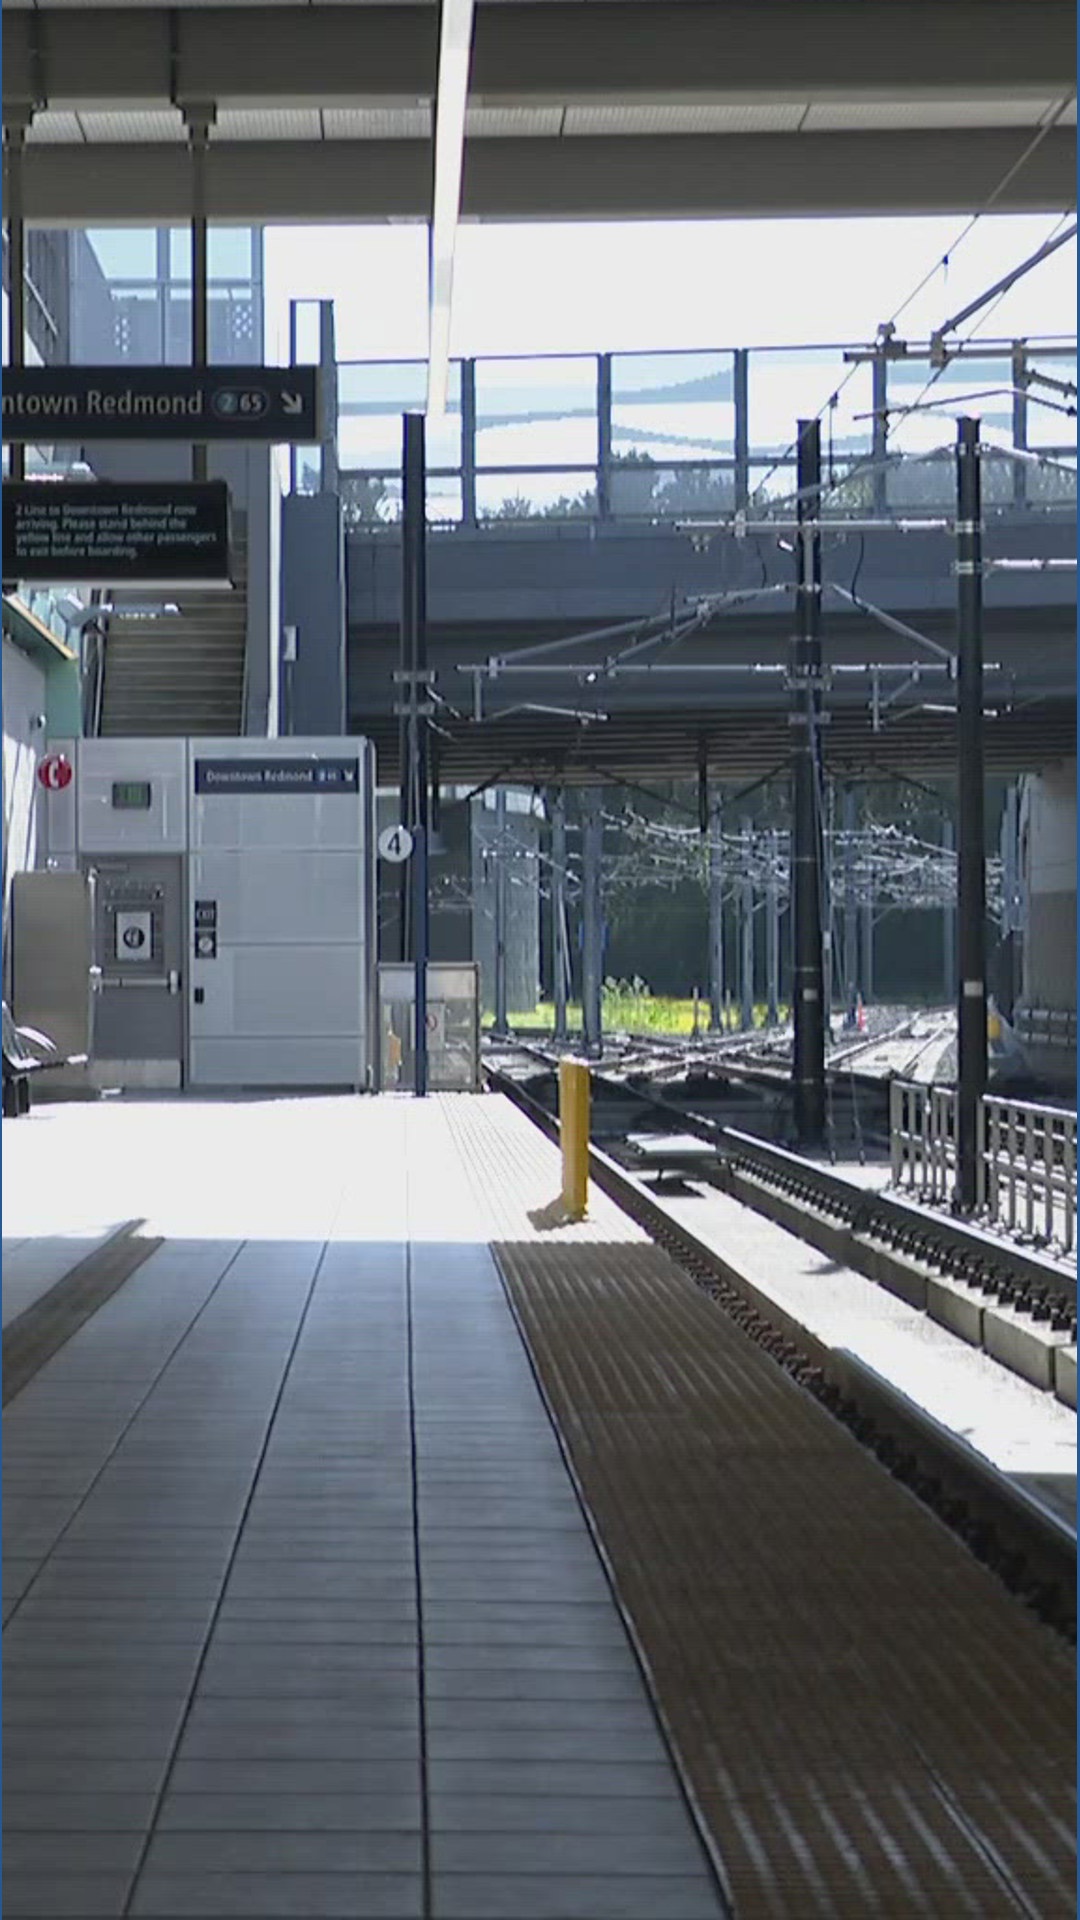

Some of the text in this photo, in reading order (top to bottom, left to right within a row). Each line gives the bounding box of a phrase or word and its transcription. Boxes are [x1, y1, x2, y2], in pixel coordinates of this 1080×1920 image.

[87, 389, 202, 414] Redmond
[239, 394, 262, 413] 65
[62, 504, 119, 515] Downtown
[121, 504, 172, 515] Redmond
[62, 518, 96, 530] Please
[98, 518, 128, 529] stand
[130, 518, 167, 529] behind
[168, 518, 187, 529] the
[16, 532, 217, 546] yellow line and allow other passengers
[16, 546, 27, 557] to
[51, 546, 85, 557] before
[206, 769, 262, 783] Downtown
[264, 769, 313, 783] Redmond
[387, 832, 402, 856] 4
